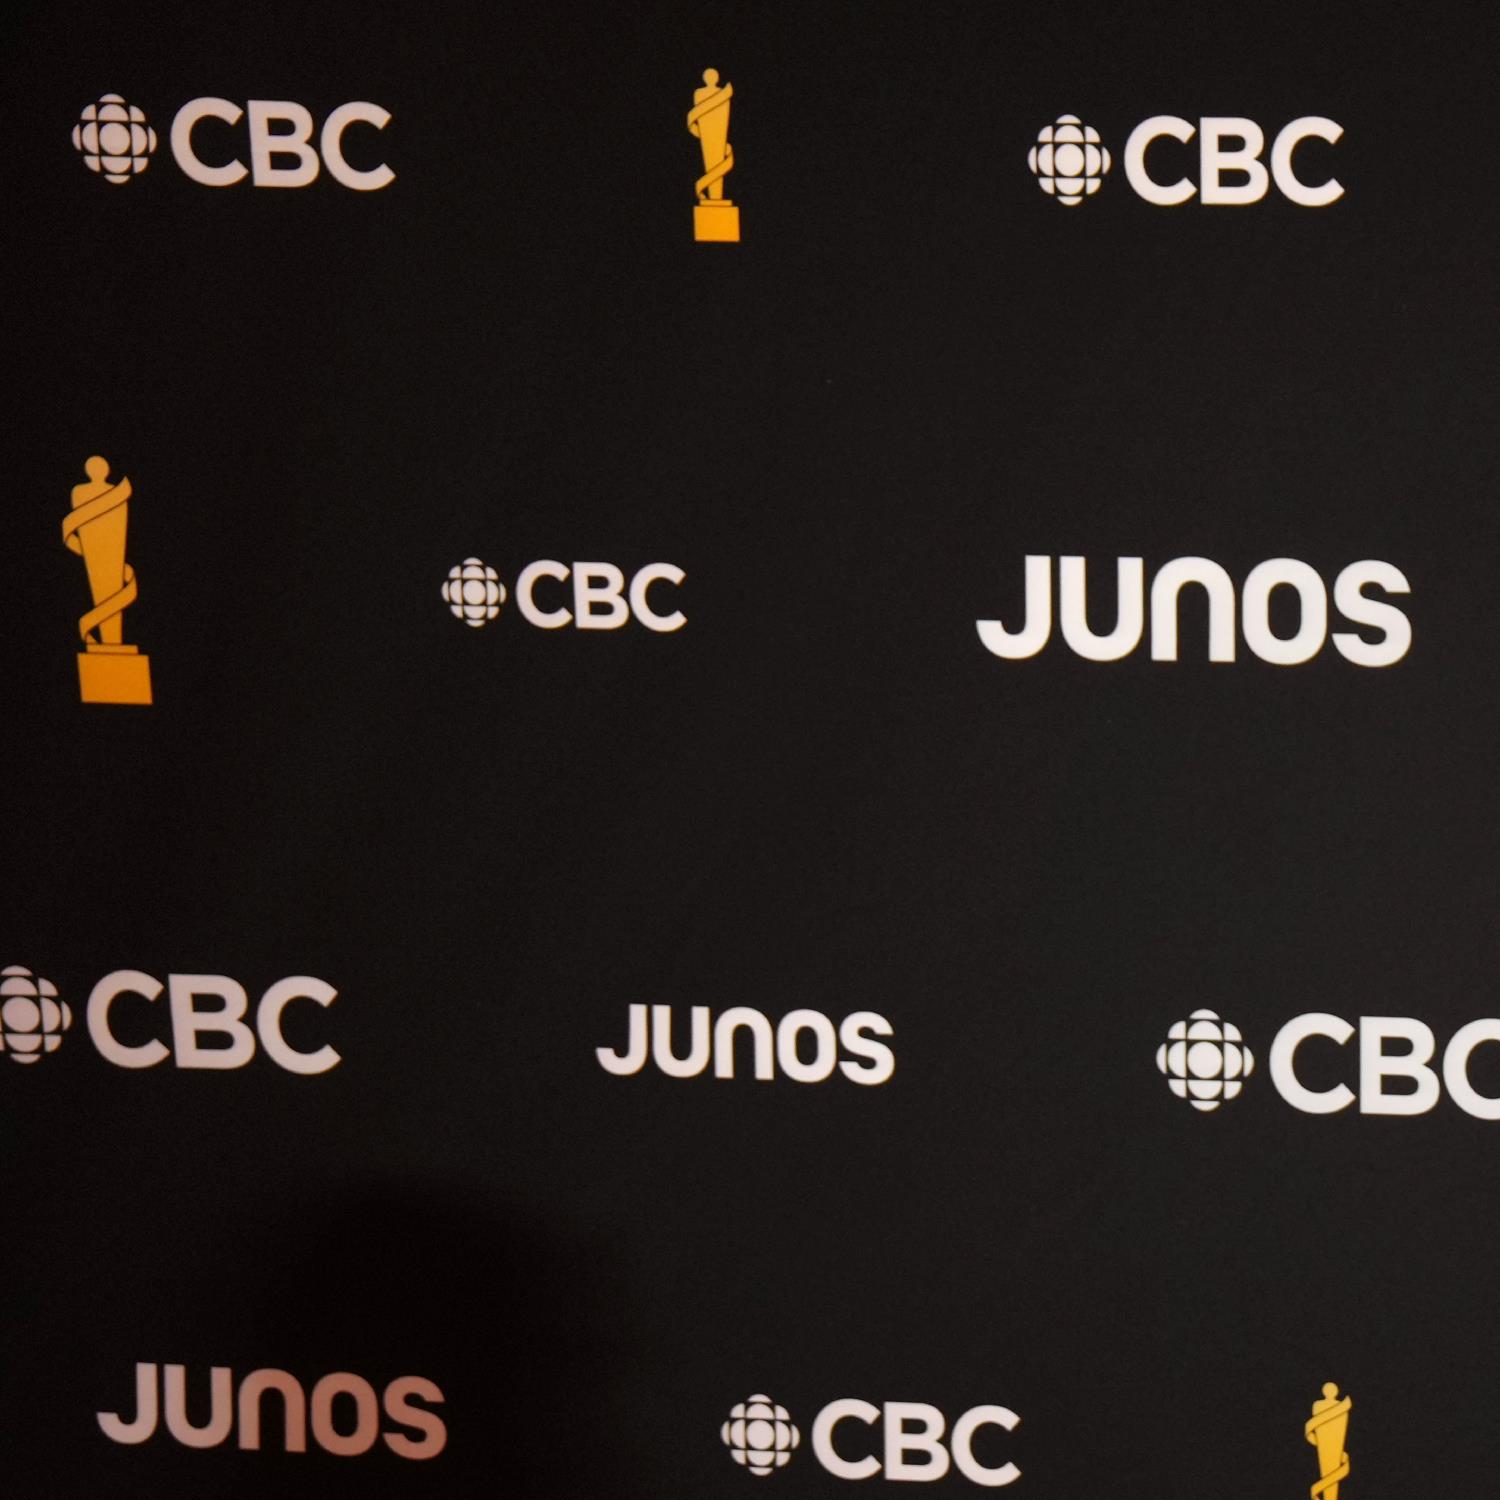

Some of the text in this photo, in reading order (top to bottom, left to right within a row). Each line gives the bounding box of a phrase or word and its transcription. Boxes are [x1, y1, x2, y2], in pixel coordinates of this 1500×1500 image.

[170, 97, 396, 191] CBC
[1124, 115, 1345, 207] CBC
[516, 559, 688, 632] CBC
[976, 555, 1412, 668] JUNOS
[86, 969, 342, 1075] CBC
[596, 1003, 895, 1086] JUNOS
[97, 1362, 447, 1460] JUNOS
[812, 1398, 1021, 1487] CBC
